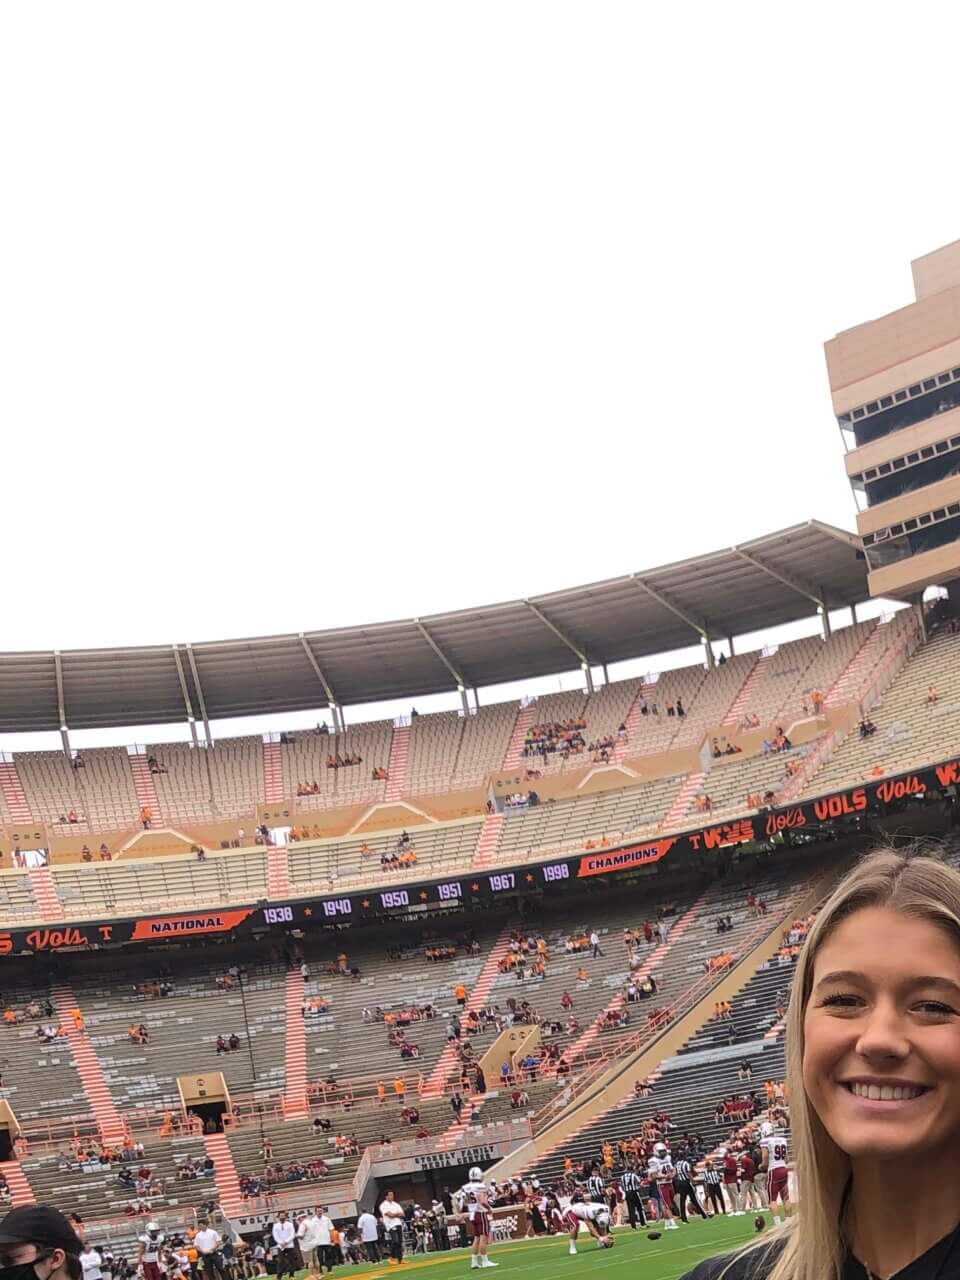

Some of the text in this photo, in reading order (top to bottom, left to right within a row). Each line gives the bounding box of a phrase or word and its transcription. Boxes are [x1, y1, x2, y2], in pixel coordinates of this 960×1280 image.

[814, 789, 867, 820] VOLS
[689, 835, 701, 849] T
[588, 847, 658, 871] CHAMPIONS
[264, 864, 570, 924] 1938 1940 1950 1951 1967 1998
[99, 927, 112, 941] T
[151, 917, 224, 933] NATIONAL
[26, 927, 88, 948] Vols
